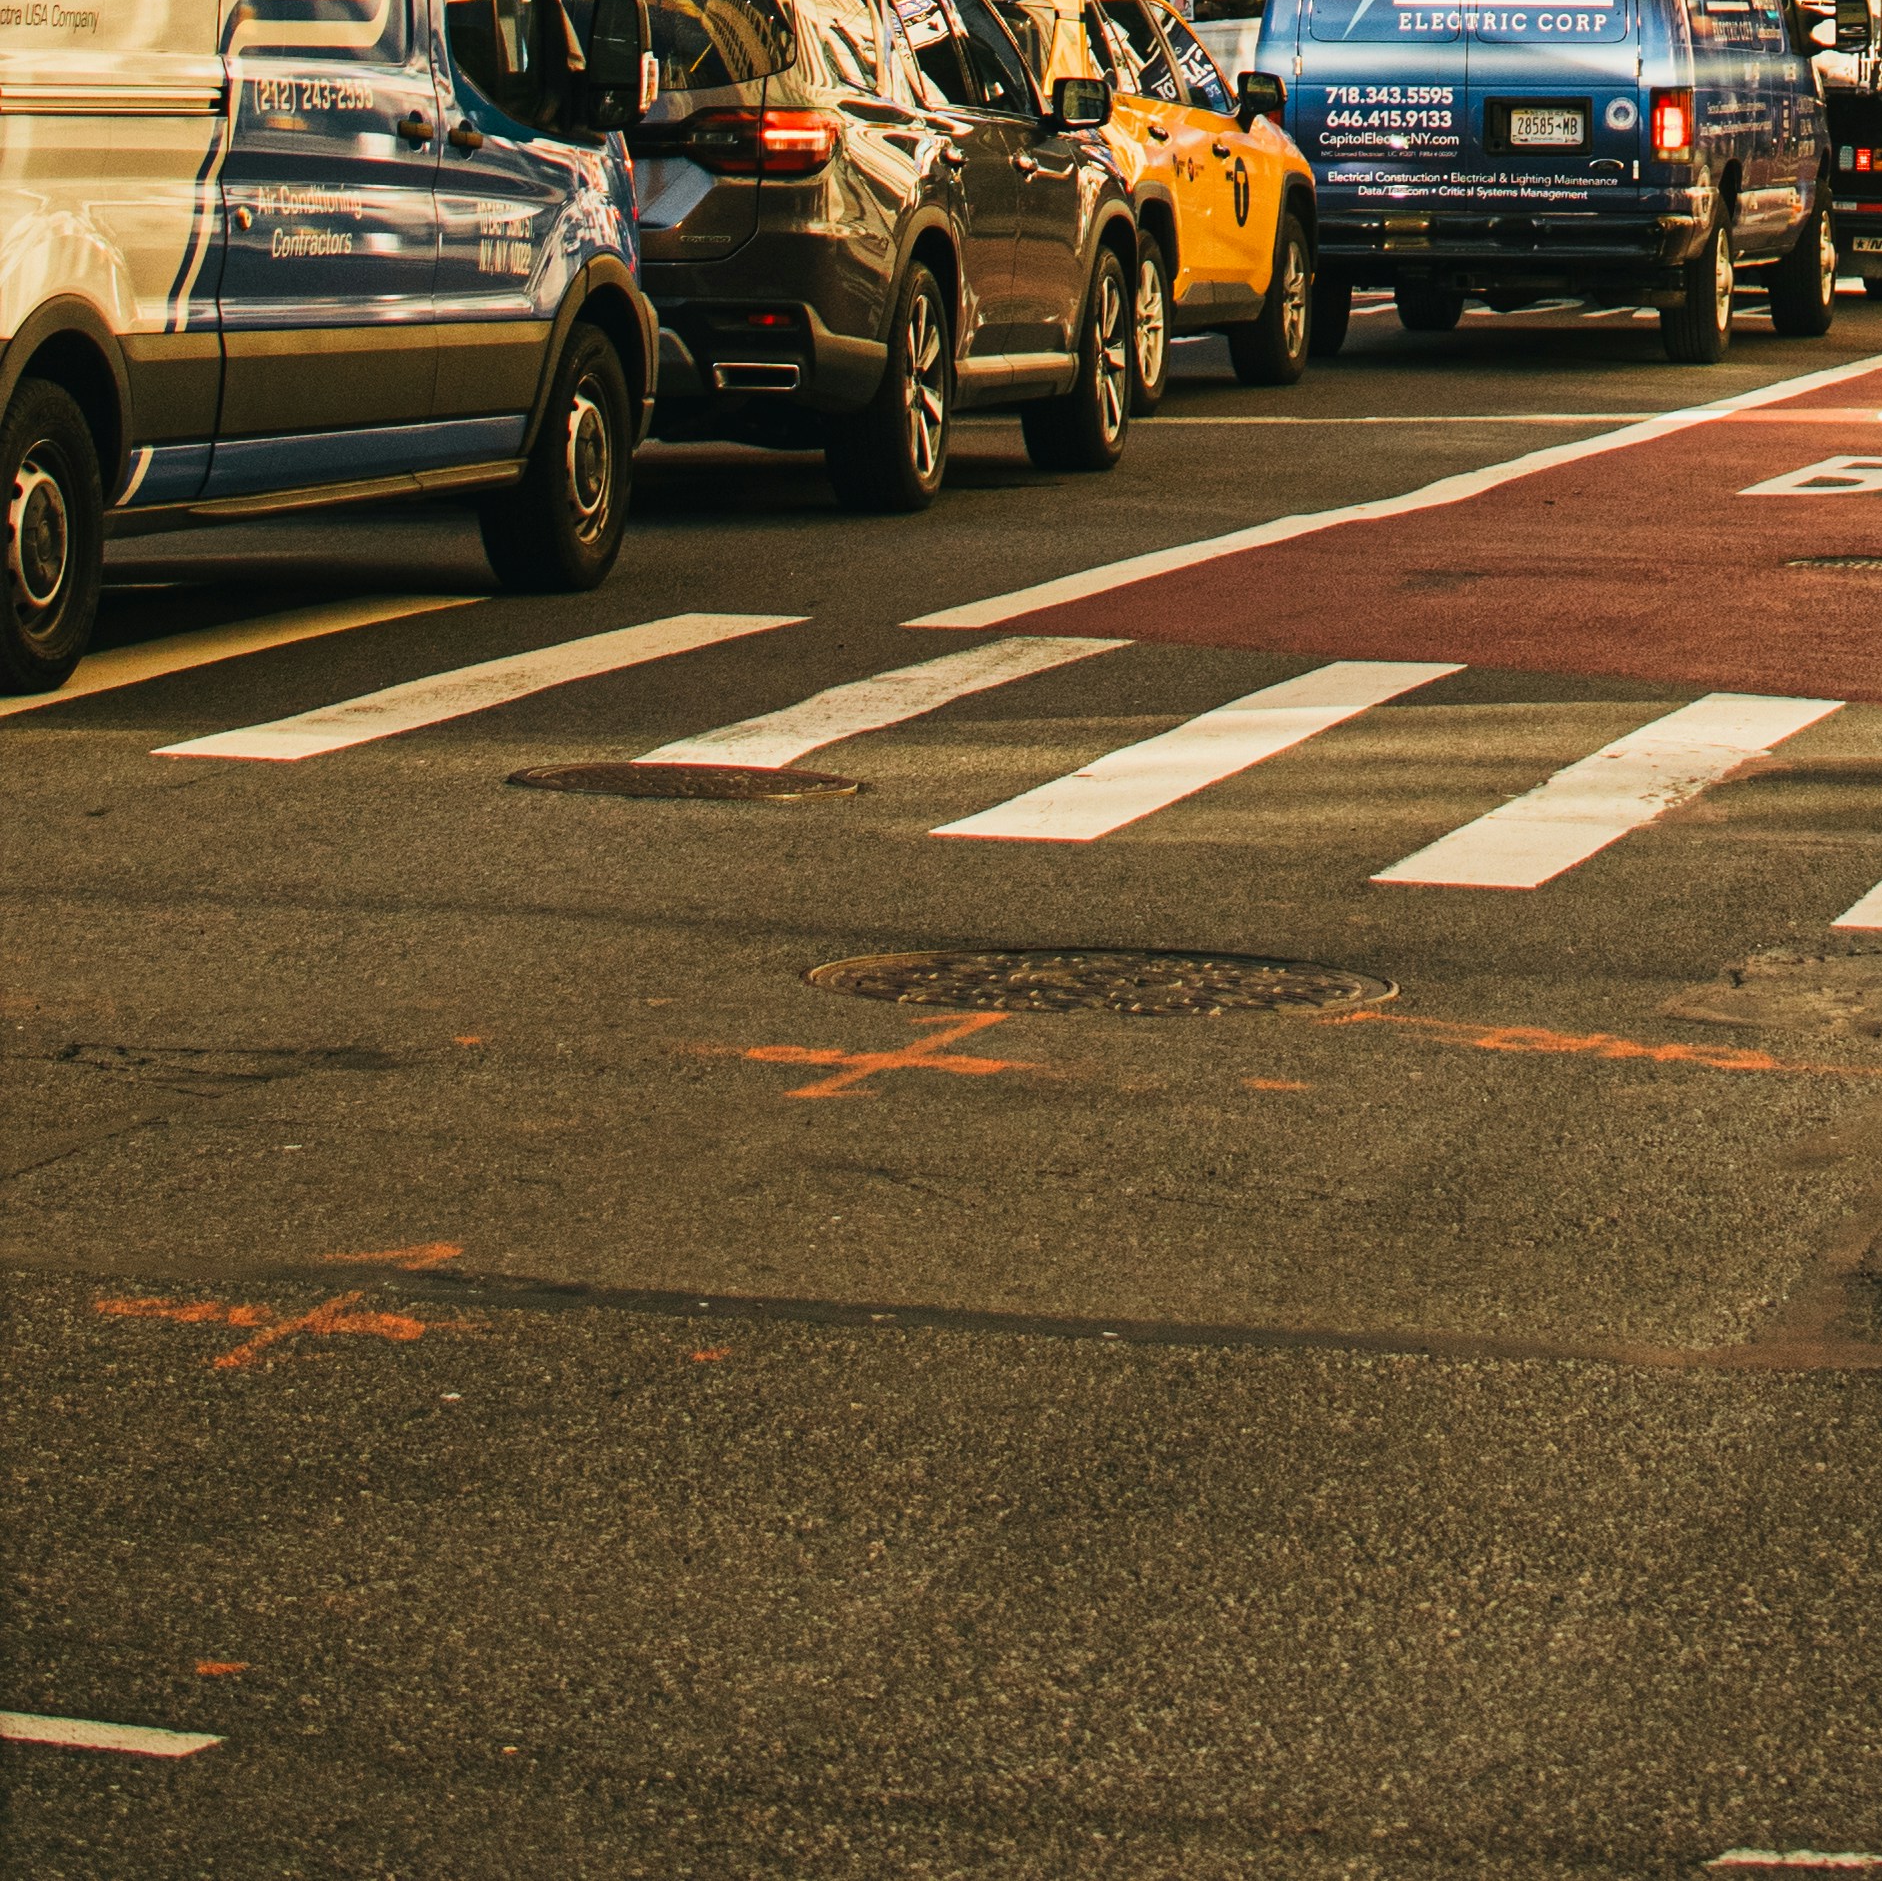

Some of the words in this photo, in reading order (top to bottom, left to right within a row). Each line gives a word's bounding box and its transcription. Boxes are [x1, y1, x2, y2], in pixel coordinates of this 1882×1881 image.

[25, 3, 48, 26] USA
[52, 4, 100, 35] Company
[1398, 13, 1526, 32] ELECTRIC
[1538, 14, 1608, 32] CORP
[254, 77, 296, 114] (212)
[301, 81, 375, 111] 243-2555
[1325, 87, 1454, 105] 718.343.5595
[1326, 110, 1453, 128] 646.415.9133
[1328, 171, 1373, 183] Electrical
[1375, 172, 1441, 183] Construction
[1450, 172, 1498, 184] Electrical
[1500, 173, 1508, 184] &
[1510, 173, 1552, 188] Lighting
[1554, 174, 1618, 186] Maintenance
[257, 186, 276, 216] Air
[280, 183, 362, 219] Conditioning
[1438, 186, 1475, 197] Critical
[1476, 187, 1518, 200] Systems
[1520, 188, 1588, 200] Management
[271, 228, 353, 258] Contractors
